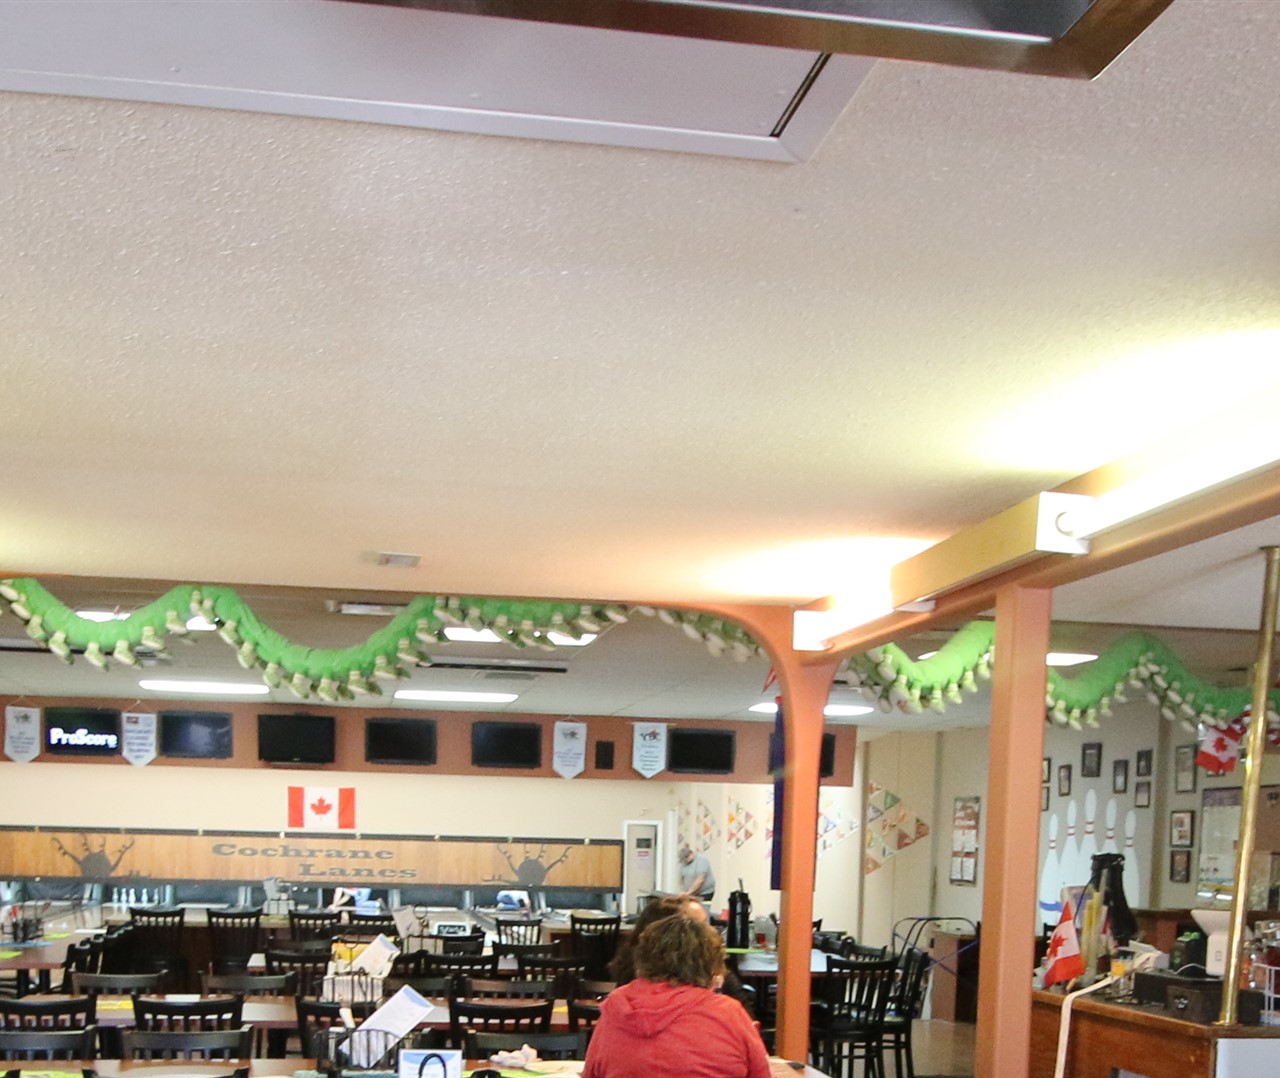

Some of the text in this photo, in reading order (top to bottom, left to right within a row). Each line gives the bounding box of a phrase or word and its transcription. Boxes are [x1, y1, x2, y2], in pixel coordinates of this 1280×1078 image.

[50, 727, 118, 749] ProScore
[212, 843, 394, 860] Cochrane
[298, 863, 418, 878] Lanes
